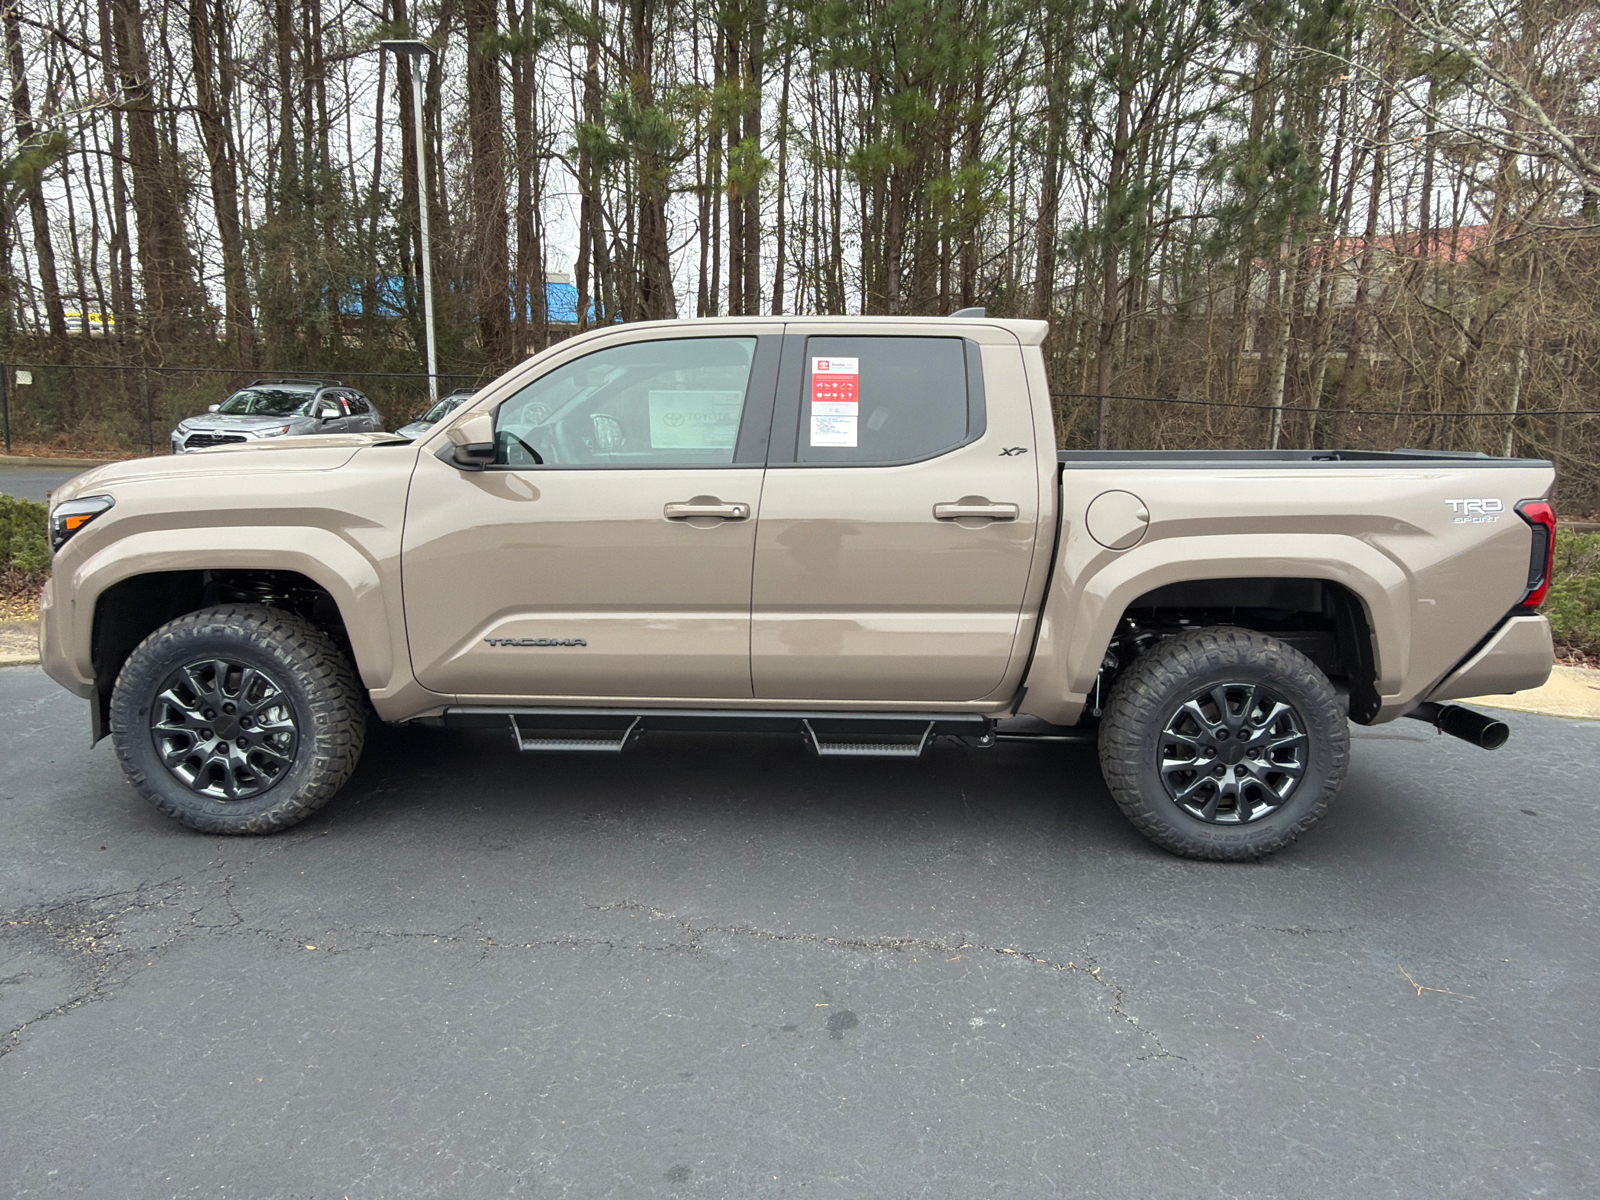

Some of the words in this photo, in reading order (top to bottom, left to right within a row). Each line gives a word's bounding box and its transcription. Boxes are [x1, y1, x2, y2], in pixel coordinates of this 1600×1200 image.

[998, 446, 1028, 457] XP
[1445, 498, 1503, 515] TRD
[1453, 516, 1500, 524] SPORT
[484, 638, 587, 646] TACOMA
